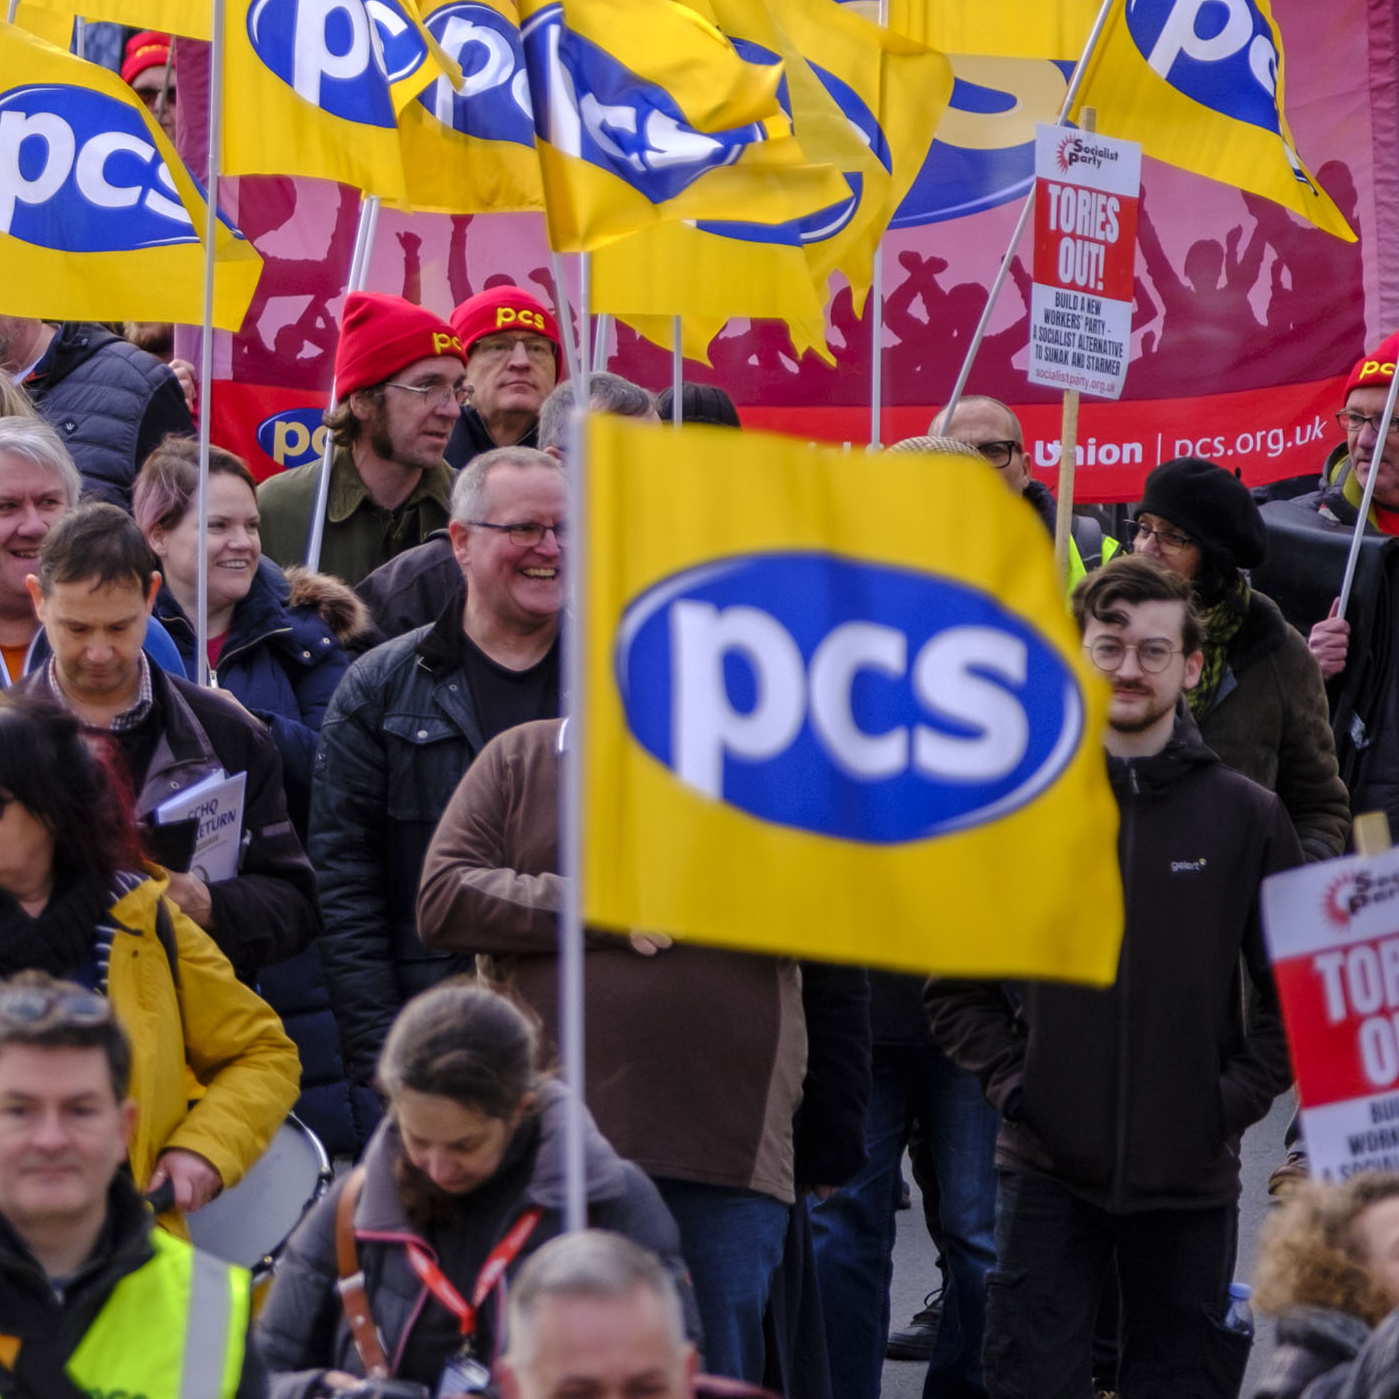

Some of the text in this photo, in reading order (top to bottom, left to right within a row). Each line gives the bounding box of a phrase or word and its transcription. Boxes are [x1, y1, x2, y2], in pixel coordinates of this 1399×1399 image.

[1073, 138, 1119, 162] Socialist
[1048, 183, 1121, 244] TORIES
[1058, 236, 1106, 291] OUT!
[1054, 291, 1079, 313] BUILD
[496, 306, 545, 330] pcs
[1085, 316, 1107, 335] PARTY
[432, 332, 464, 355] pc
[1038, 326, 1077, 350] SOCIALIST
[1078, 335, 1124, 359] ALTERNATIVE
[1044, 346, 1070, 366] SUNAK
[1071, 352, 1086, 368] AND
[1086, 355, 1121, 377] STARMER
[1360, 359, 1394, 380] pc
[273, 420, 329, 466] pc
[668, 599, 1030, 802] pcs
[199, 809, 237, 838] ETURN
